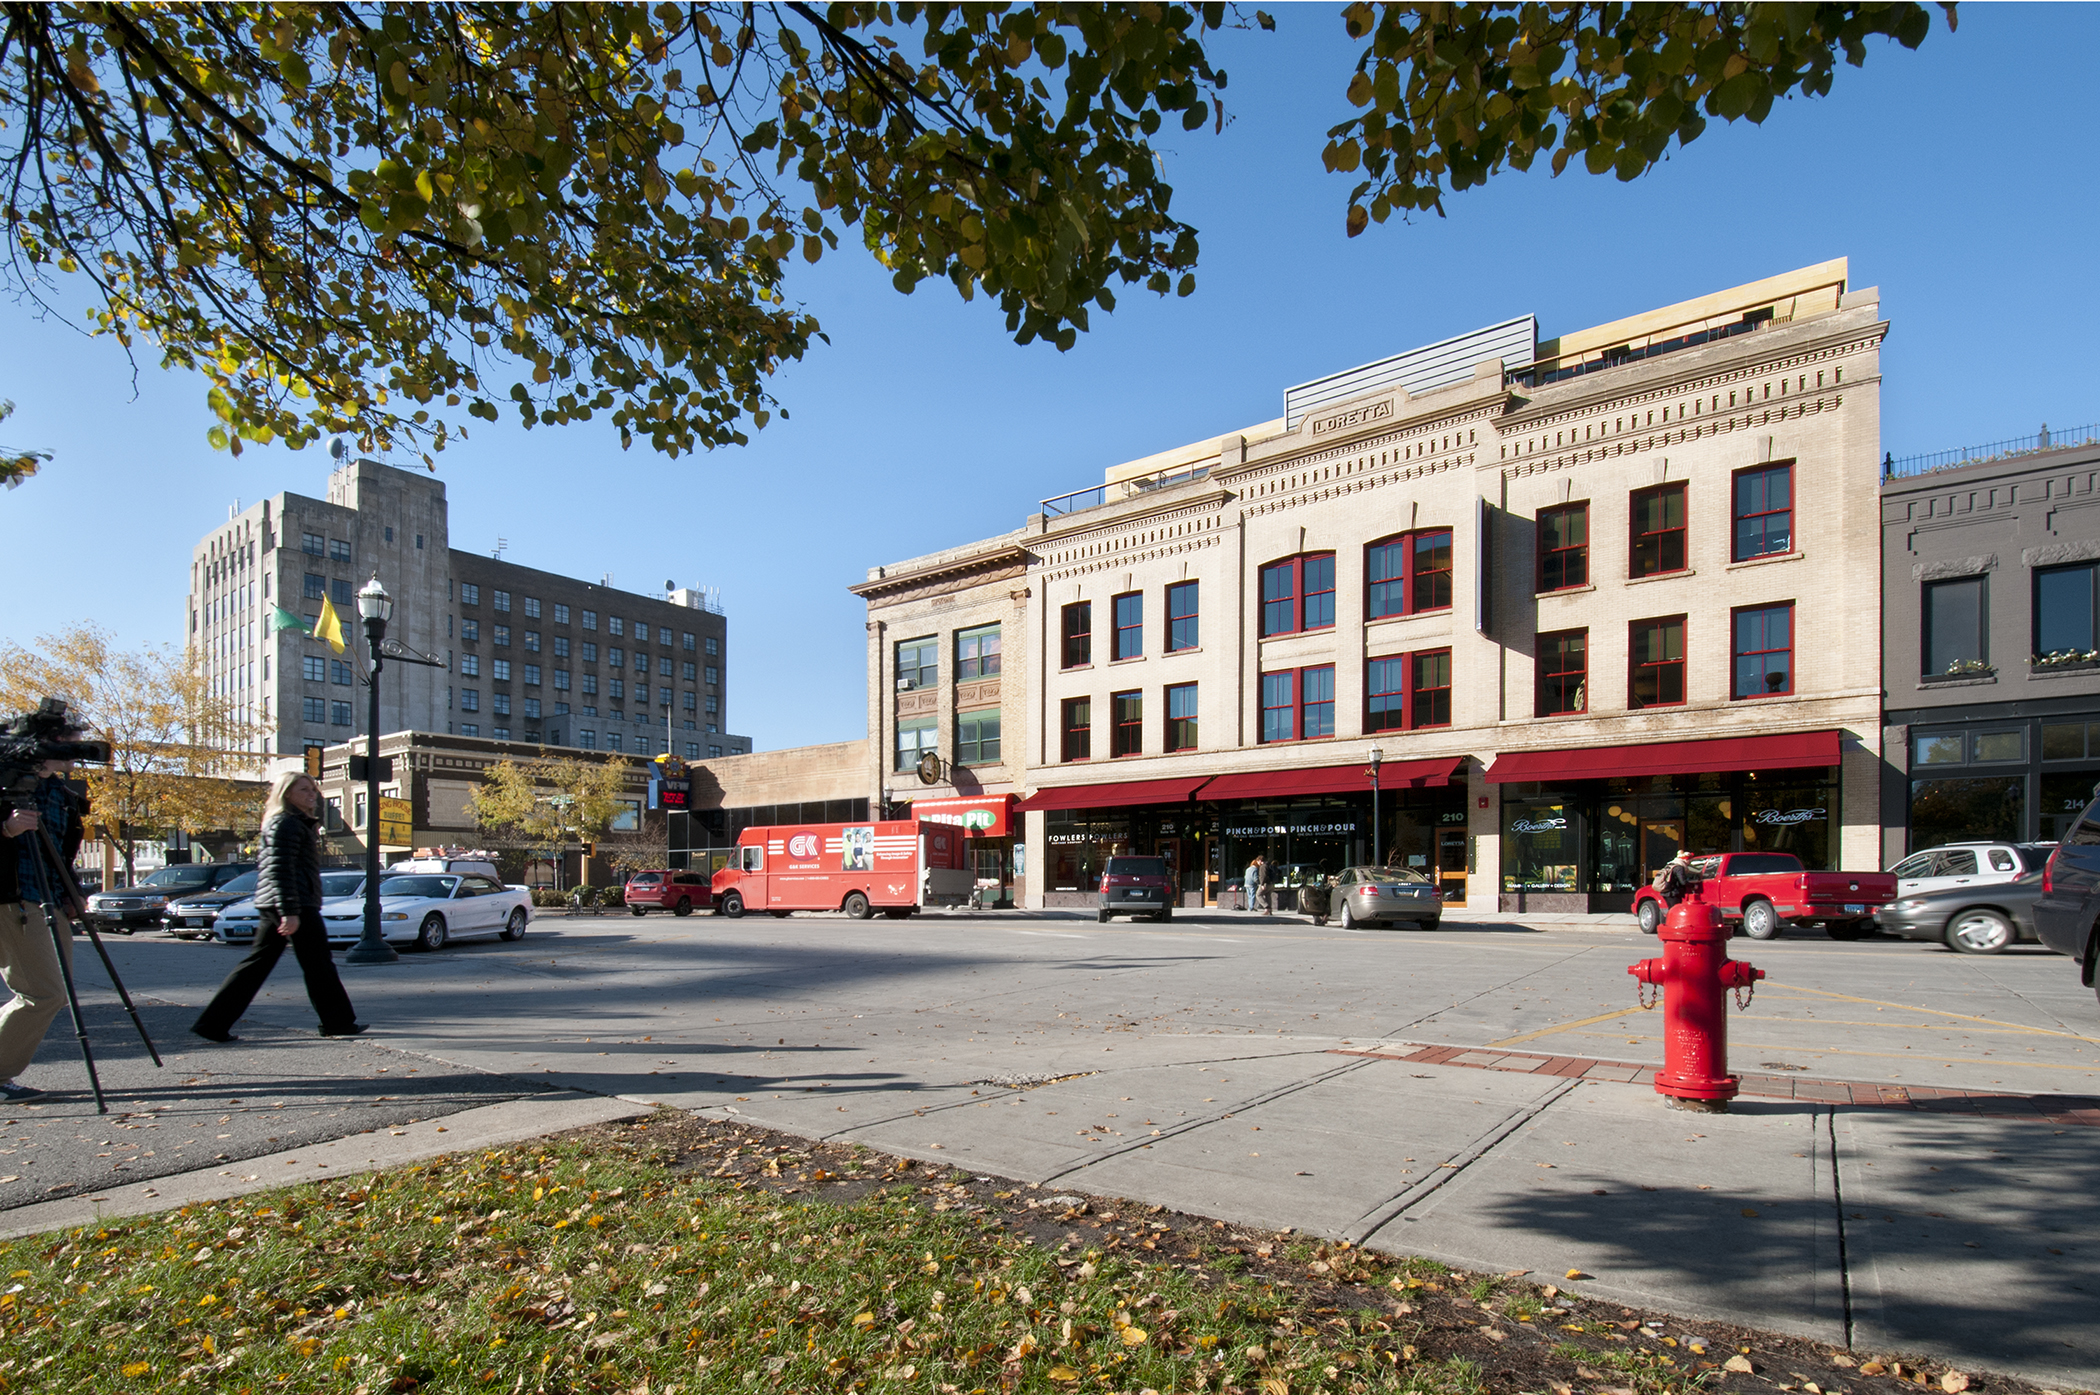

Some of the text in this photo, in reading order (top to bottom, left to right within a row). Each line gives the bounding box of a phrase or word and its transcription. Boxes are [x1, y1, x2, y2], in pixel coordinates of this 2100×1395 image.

[1315, 403, 1389, 433] LORETTA
[2064, 799, 2085, 810] 214
[383, 812, 405, 821] BUFFET
[966, 811, 990, 827] Pit
[1442, 812, 1464, 822] 210
[1048, 833, 1086, 842] FOWLERS
[789, 835, 818, 856] GK
